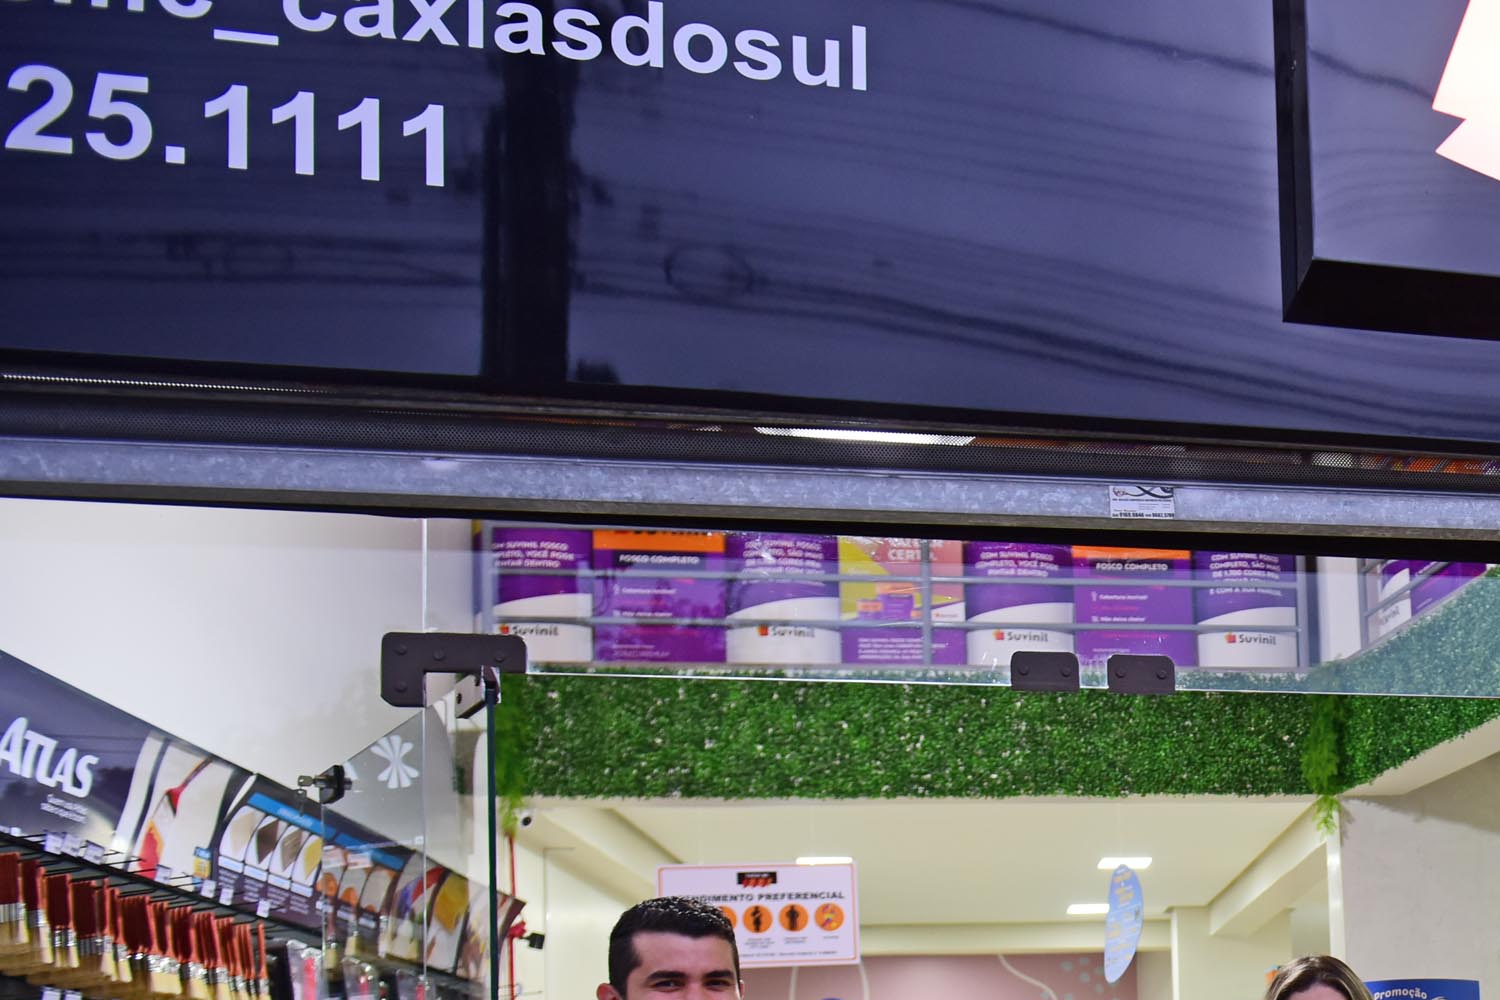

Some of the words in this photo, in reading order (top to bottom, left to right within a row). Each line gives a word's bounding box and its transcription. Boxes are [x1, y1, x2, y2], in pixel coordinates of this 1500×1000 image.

[4, 64, 445, 187] 25.1111
[1095, 561, 1123, 571] FOSCO
[1124, 562, 1168, 572] COMPLETO
[1008, 630, 1049, 643] Suvinil
[1238, 634, 1276, 646] Suvinil
[0, 716, 100, 798] ATLAS
[758, 891, 844, 901] PREFERENCIAL
